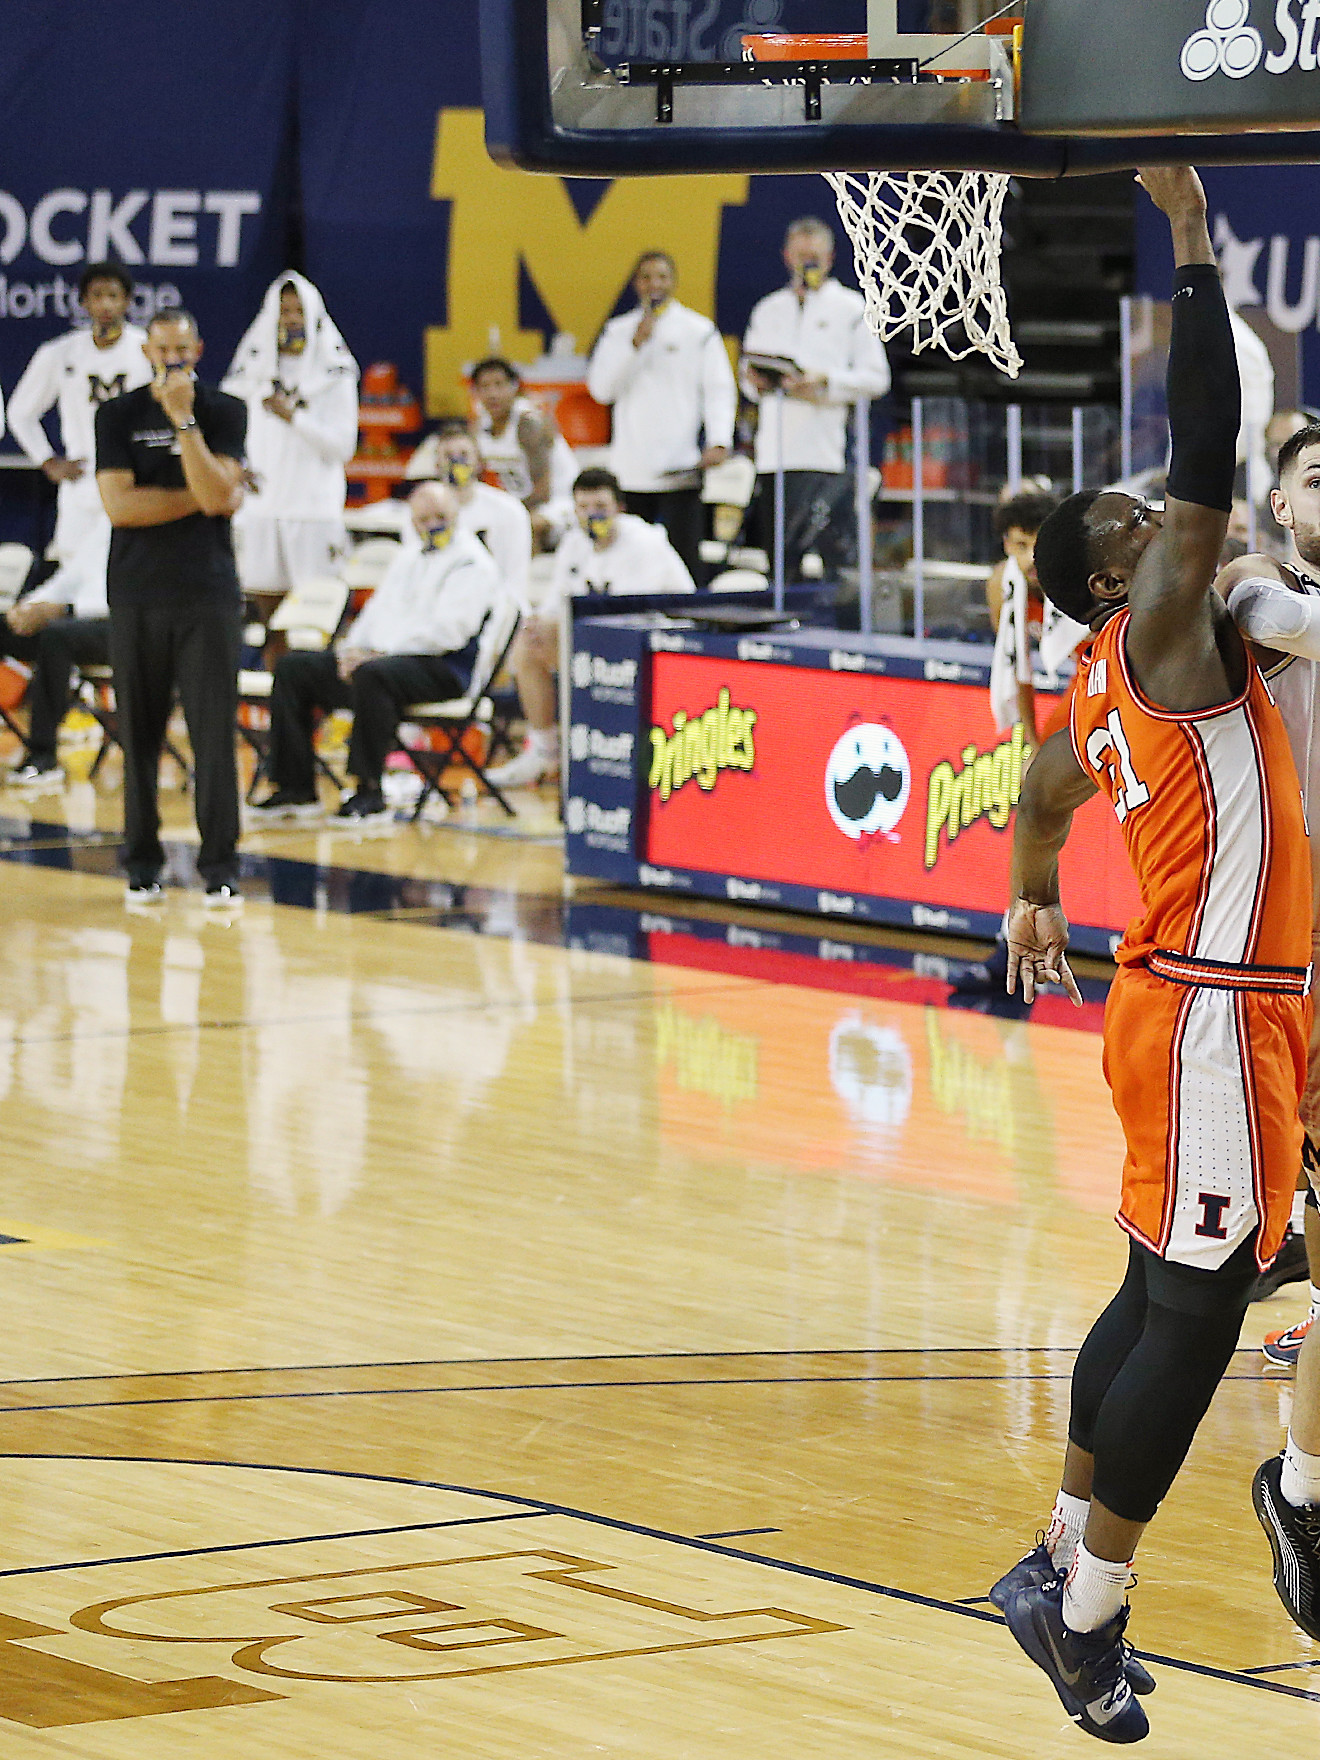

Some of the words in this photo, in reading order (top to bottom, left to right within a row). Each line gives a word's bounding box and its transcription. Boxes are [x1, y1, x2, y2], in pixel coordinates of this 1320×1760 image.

[924, 721, 1030, 869] Pringl
[1086, 707, 1150, 824] 21
[1195, 1192, 1231, 1240] I
